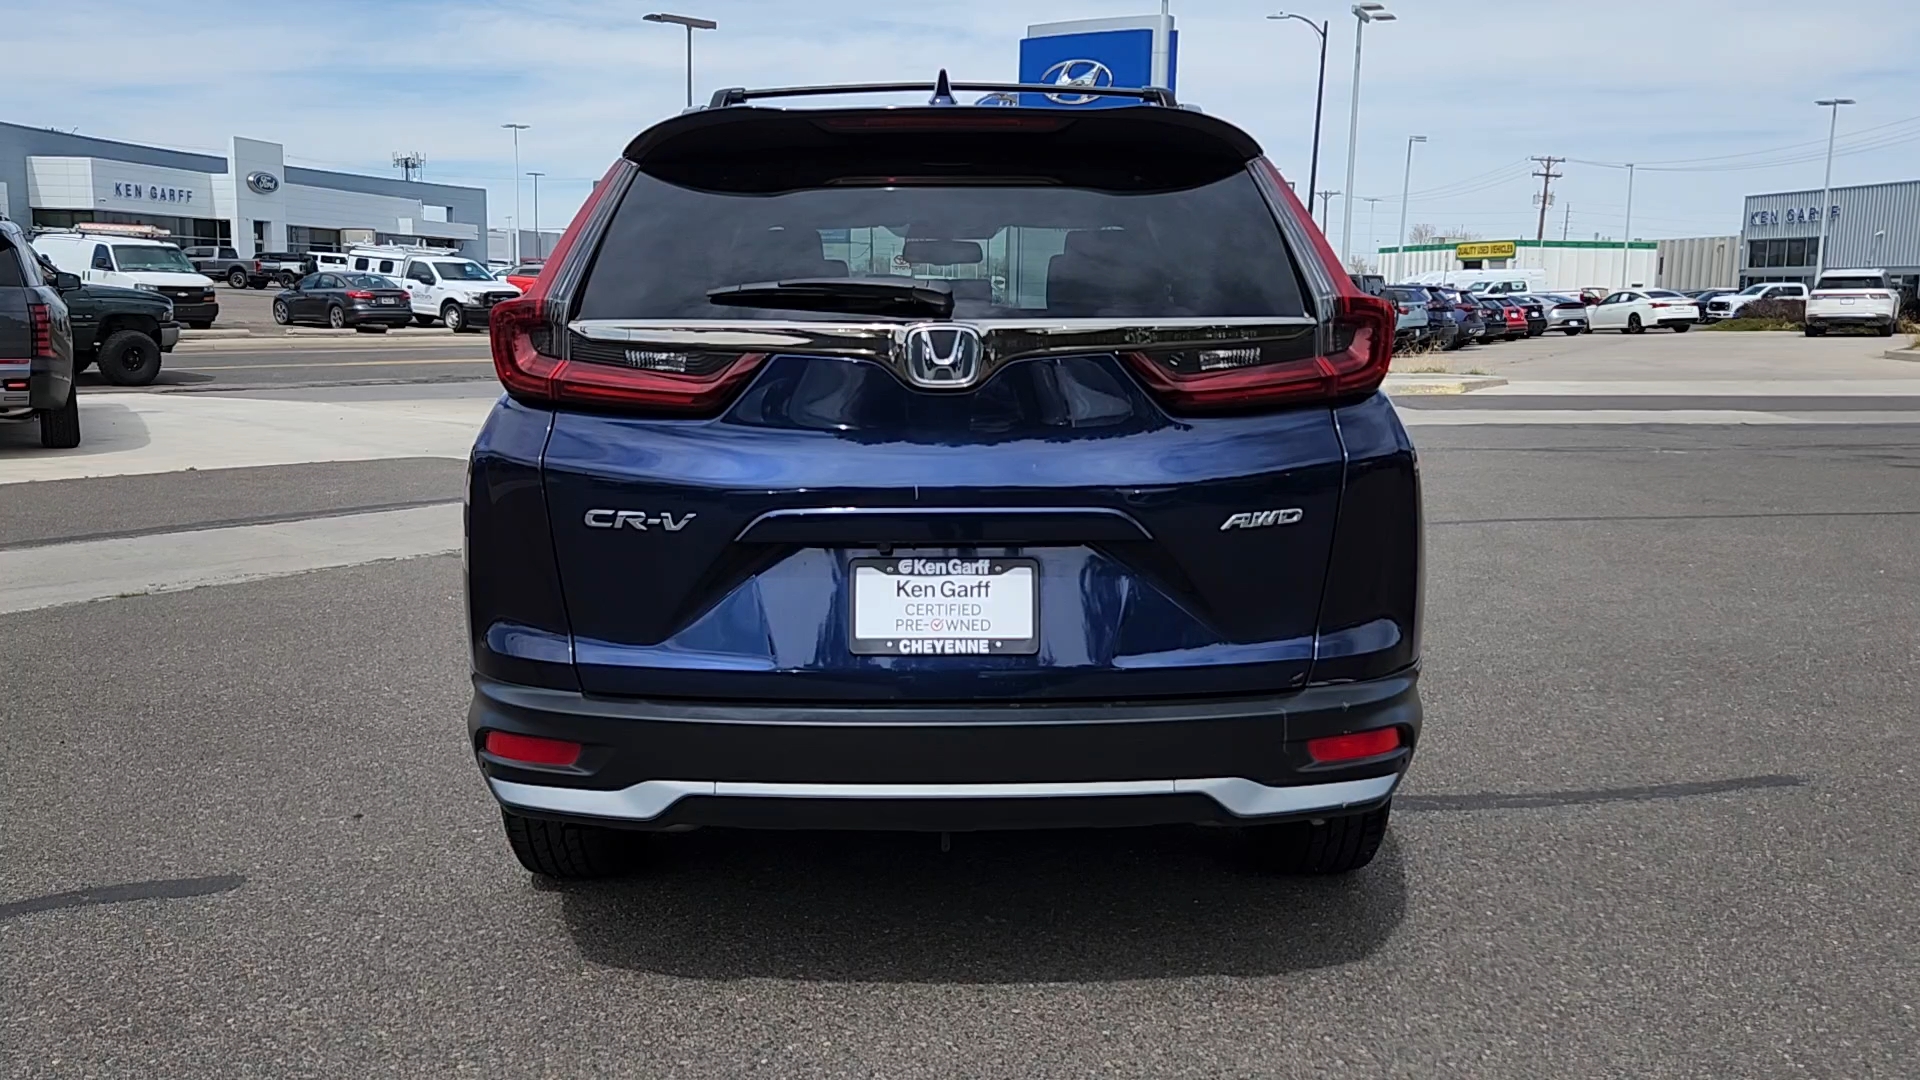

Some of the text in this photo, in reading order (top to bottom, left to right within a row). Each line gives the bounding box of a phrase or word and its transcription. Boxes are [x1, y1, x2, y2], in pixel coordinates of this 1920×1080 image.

[256, 174, 277, 191] Ford
[114, 182, 193, 203] KEN GARFF
[1750, 209, 1779, 226] KEN
[1458, 243, 1513, 256] QUALITY USED VEHICLES
[584, 508, 697, 531] CR-V
[1220, 507, 1303, 531] AWD
[913, 558, 991, 576] Ken Garff
[896, 579, 991, 598] Ken Garff
[904, 603, 982, 617] CERTIFIED
[898, 639, 990, 655] CHEYENNE
